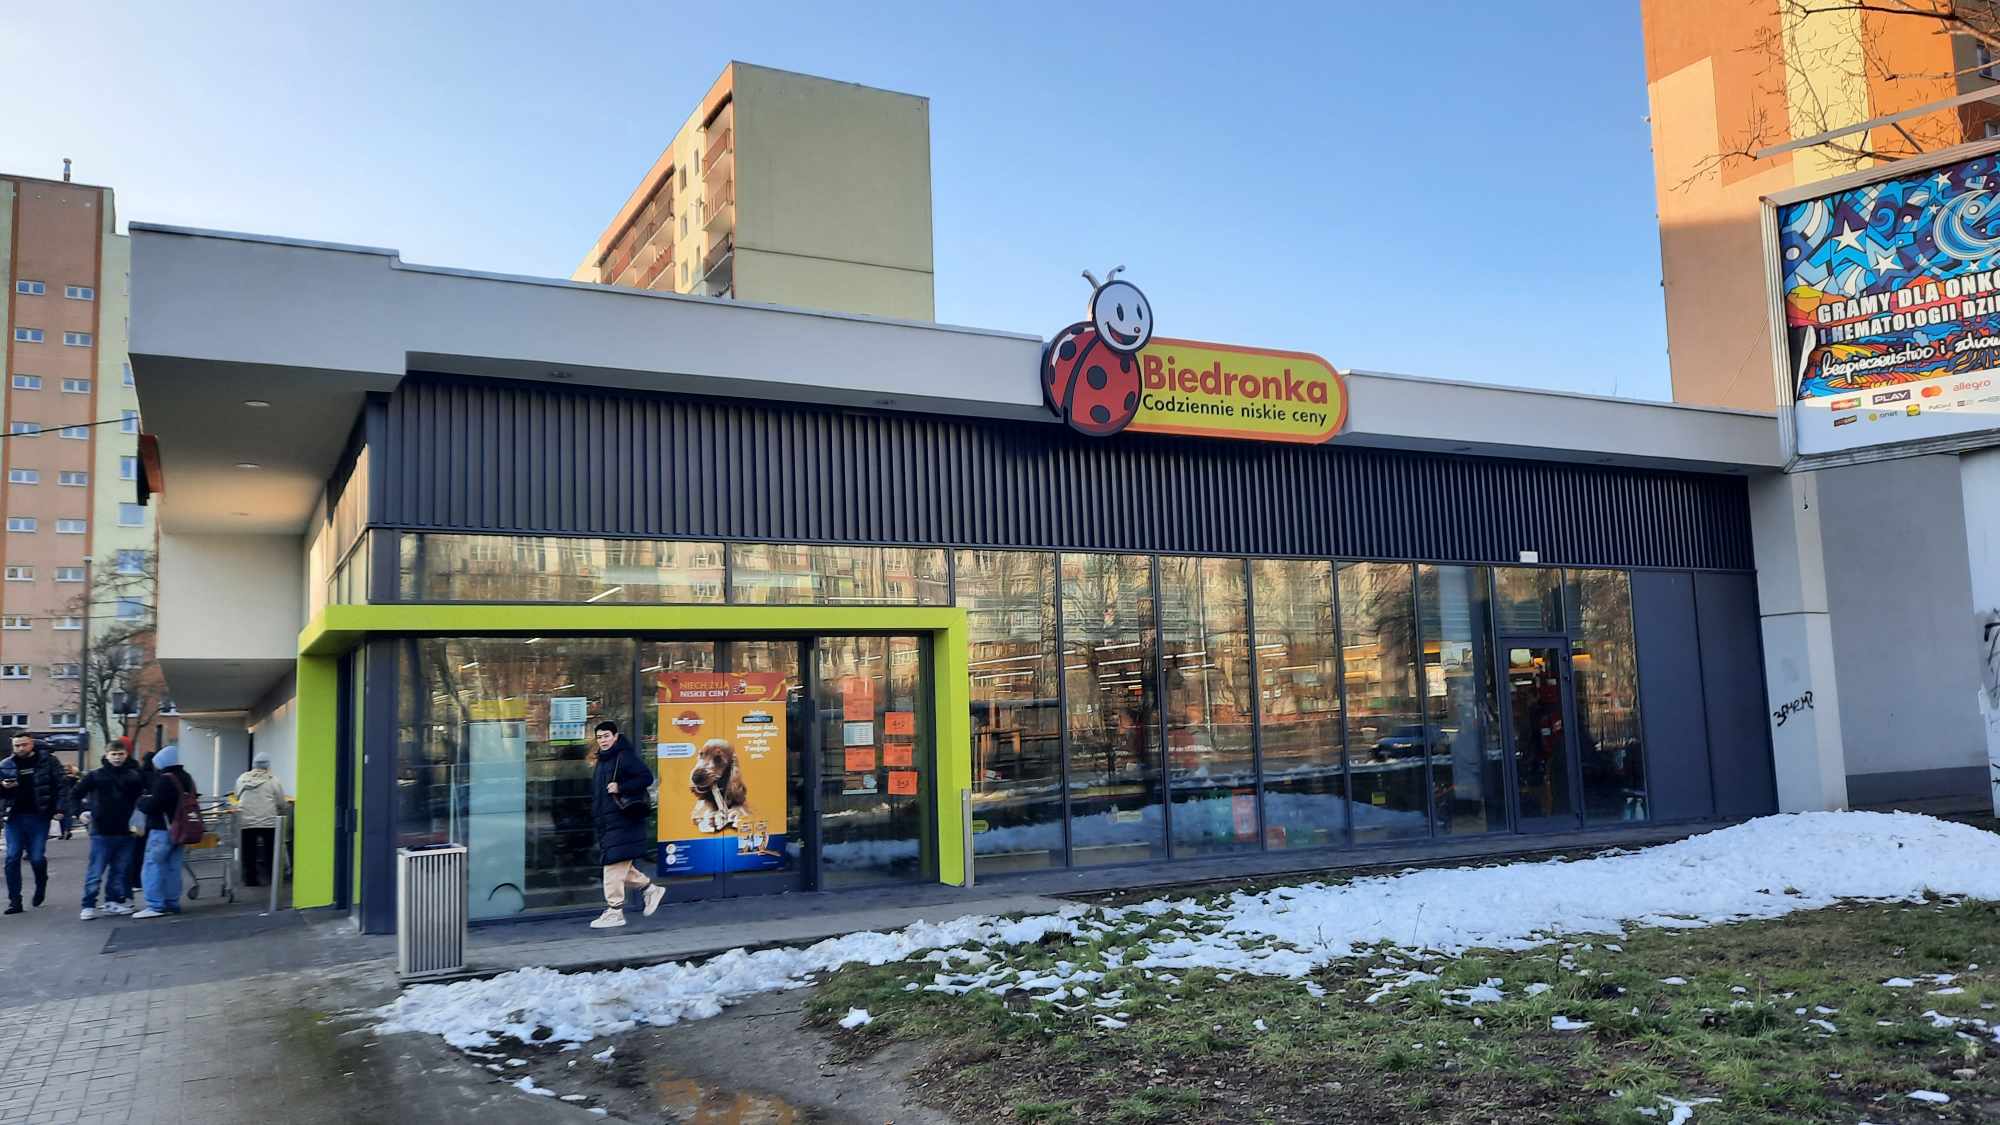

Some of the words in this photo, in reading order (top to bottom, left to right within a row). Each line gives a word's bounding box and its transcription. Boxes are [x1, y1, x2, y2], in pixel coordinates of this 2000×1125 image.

[1817, 292, 1890, 323] GRAMY
[1898, 282, 1940, 308] DLA
[1820, 329, 1826, 344] I
[1831, 303, 1957, 343] HEMATOLOGII
[1940, 341, 1946, 354] i
[1142, 354, 1328, 404] Biedronka
[1874, 391, 1907, 403] PLAY
[1953, 379, 1991, 391] allegro
[1142, 393, 1234, 416] Codziennie
[1241, 402, 1286, 421] niskie
[1292, 411, 1327, 427] ceny
[680, 690, 706, 698] NISKIE
[708, 690, 729, 698] CENY
